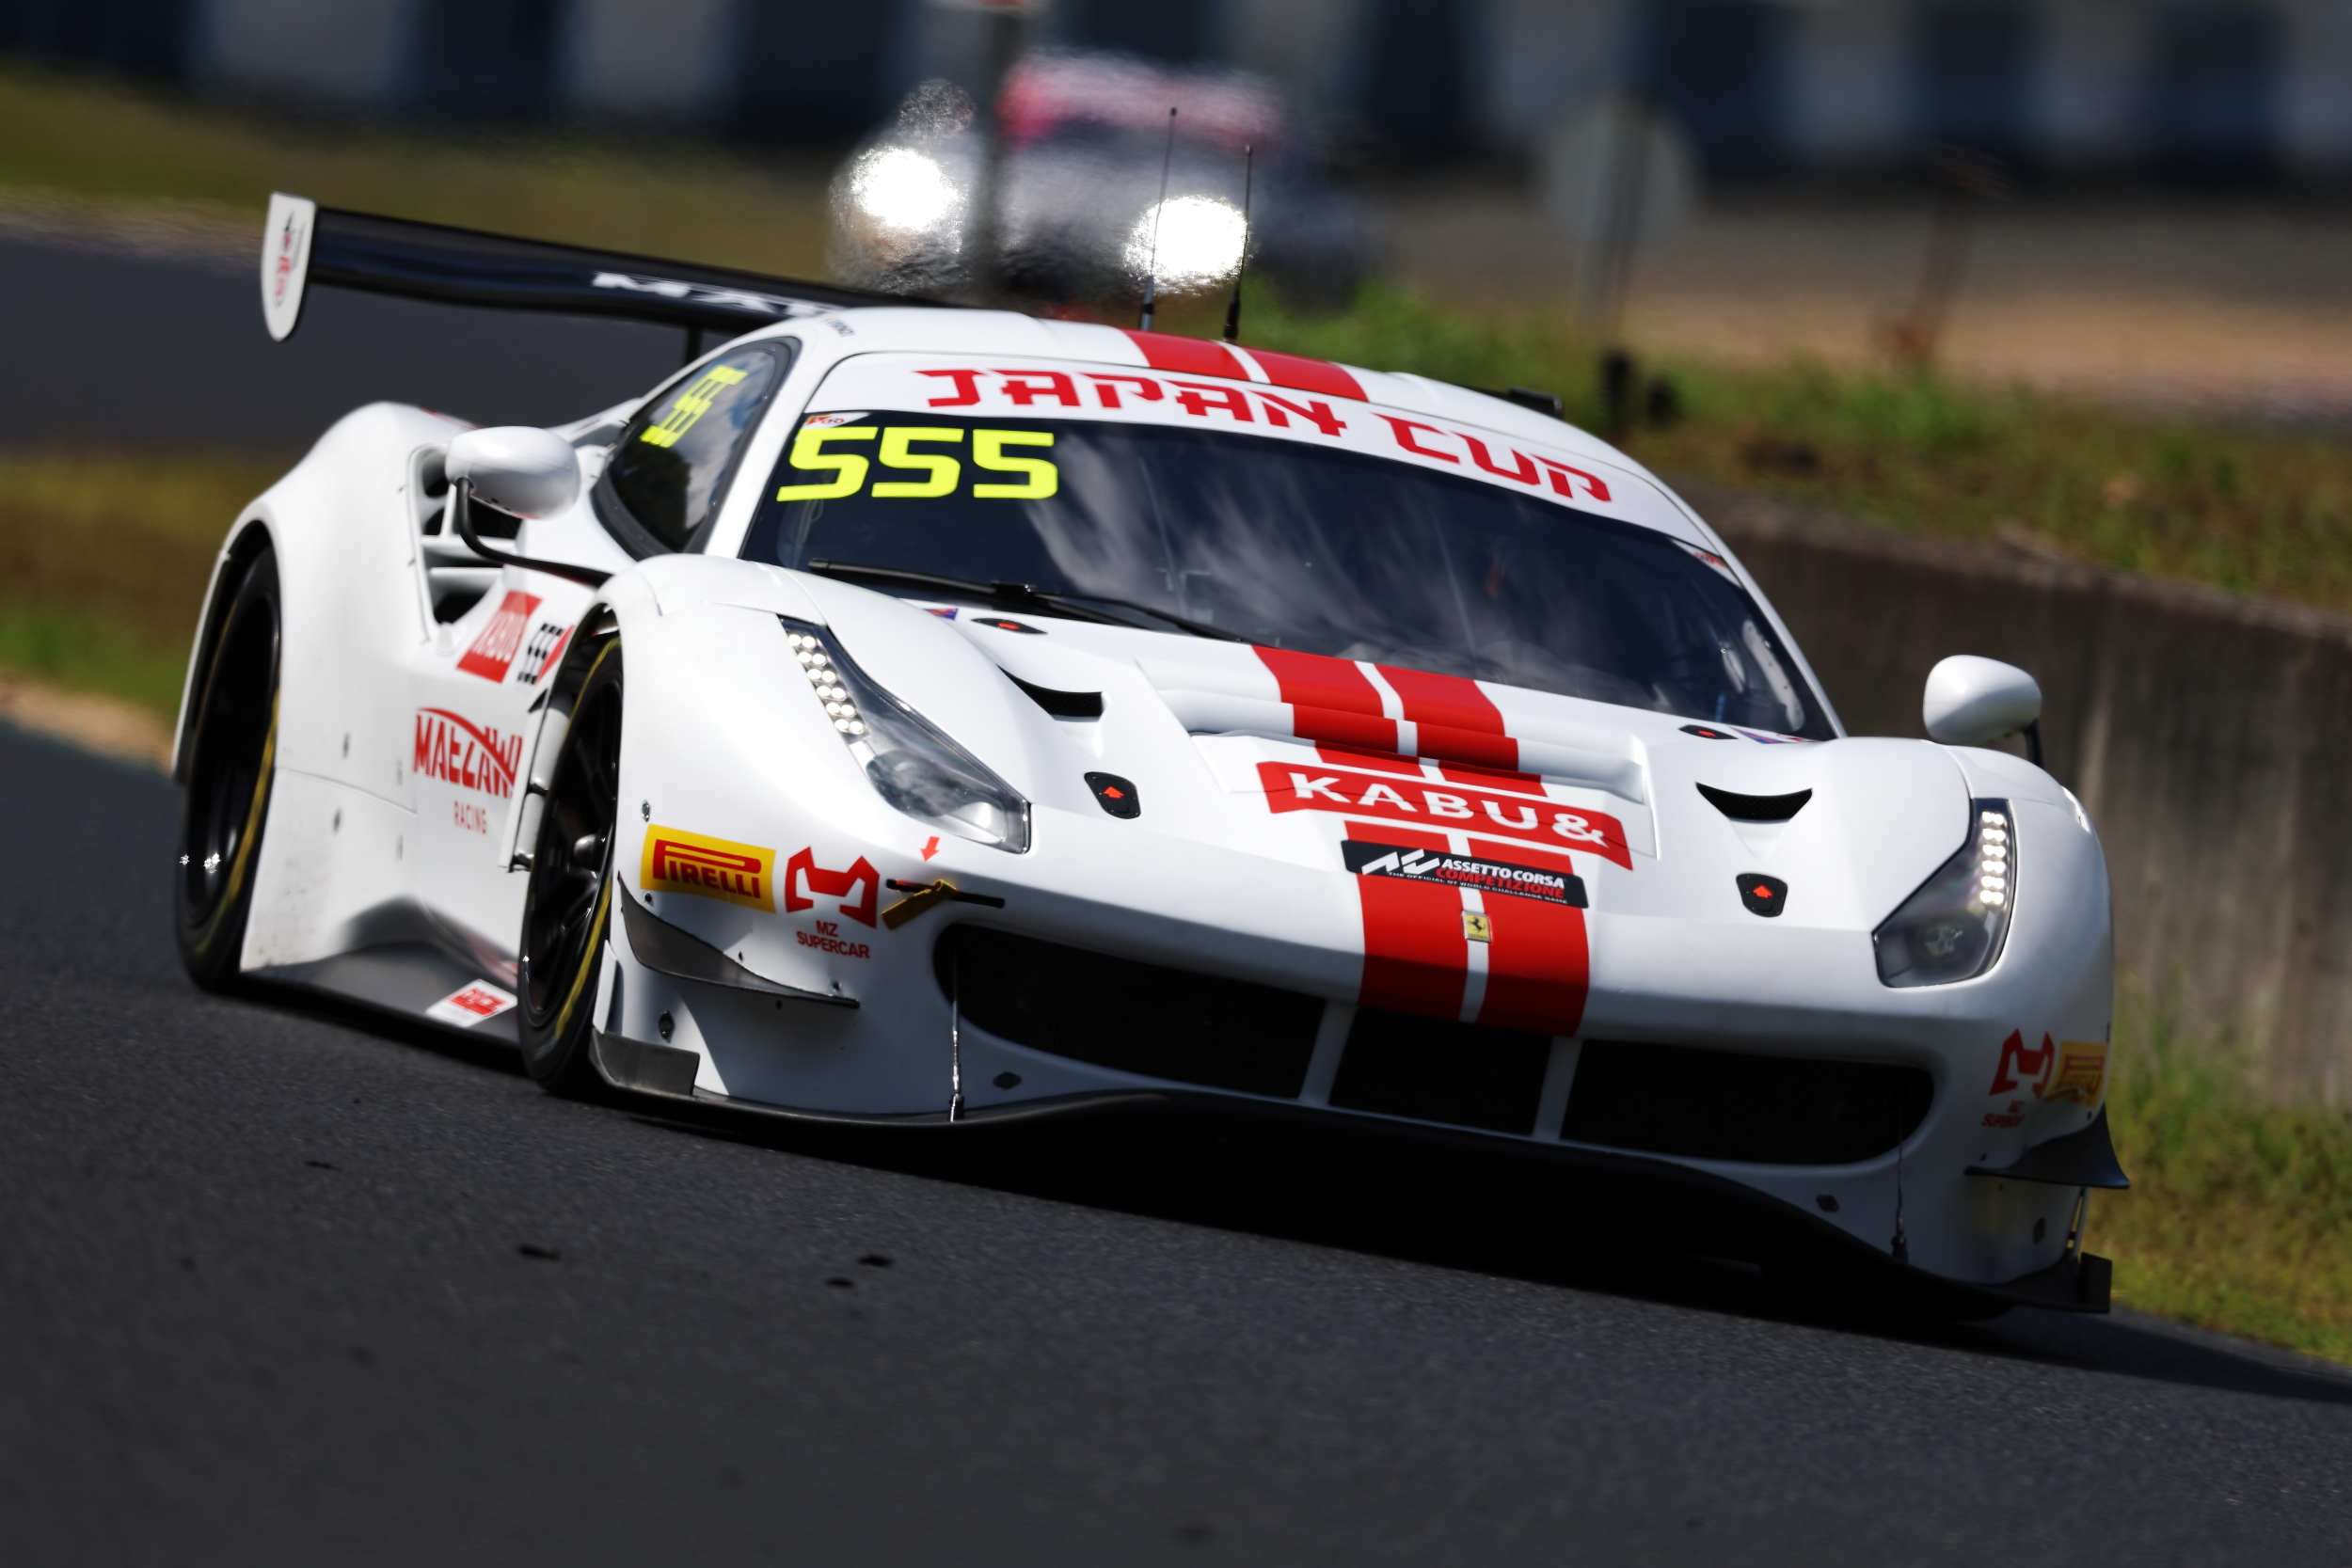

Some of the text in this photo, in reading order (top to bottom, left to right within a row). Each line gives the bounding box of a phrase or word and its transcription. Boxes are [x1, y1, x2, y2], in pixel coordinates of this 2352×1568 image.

[909, 369, 1613, 502] JAPAN CUP
[776, 426, 1058, 501] 555
[453, 800, 486, 834] RACING
[1288, 771, 1611, 849] KABU&
[652, 838, 762, 898] PIRELLI
[1436, 867, 1565, 898] COMPETIZIONE
[1441, 858, 1565, 889] ASSETTO CORSA
[1406, 874, 1446, 884] OFFICIAL
[1460, 880, 1490, 891] WORLD
[1492, 886, 1543, 900] CHALLENGE
[796, 930, 870, 959] SUPERCAR
[816, 920, 839, 937] MZ
